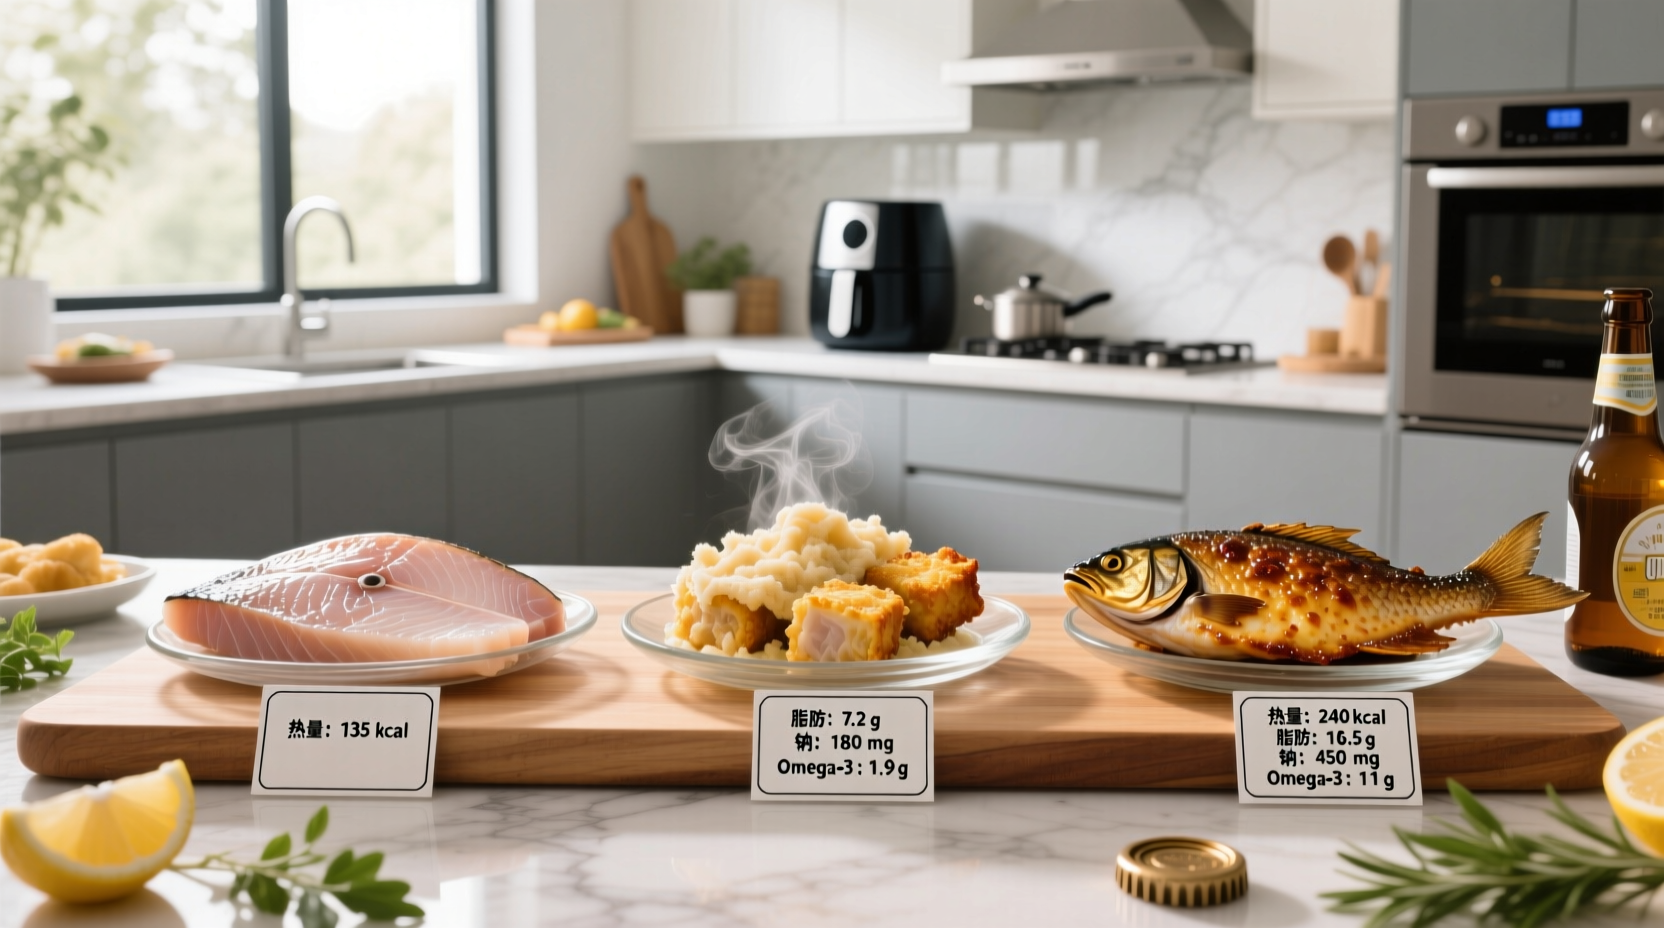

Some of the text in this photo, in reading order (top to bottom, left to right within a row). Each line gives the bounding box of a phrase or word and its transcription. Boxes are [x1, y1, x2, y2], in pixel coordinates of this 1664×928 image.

[842, 711, 865, 726] 7.2
[871, 716, 880, 731] g
[1319, 709, 1349, 723] 240
[1353, 709, 1385, 724] kcal
[341, 721, 370, 737] 135
[376, 722, 408, 738] kcal
[832, 735, 862, 750] 180
[868, 739, 893, 754] mg
[1327, 730, 1362, 745] 16.5
[1365, 735, 1375, 750] g
[1316, 750, 1346, 765] 450
[1354, 753, 1380, 769] mg
[870, 759, 895, 775] 1.9
[898, 764, 908, 780] g
[1360, 771, 1377, 785] 11
[1384, 775, 1394, 791] g
